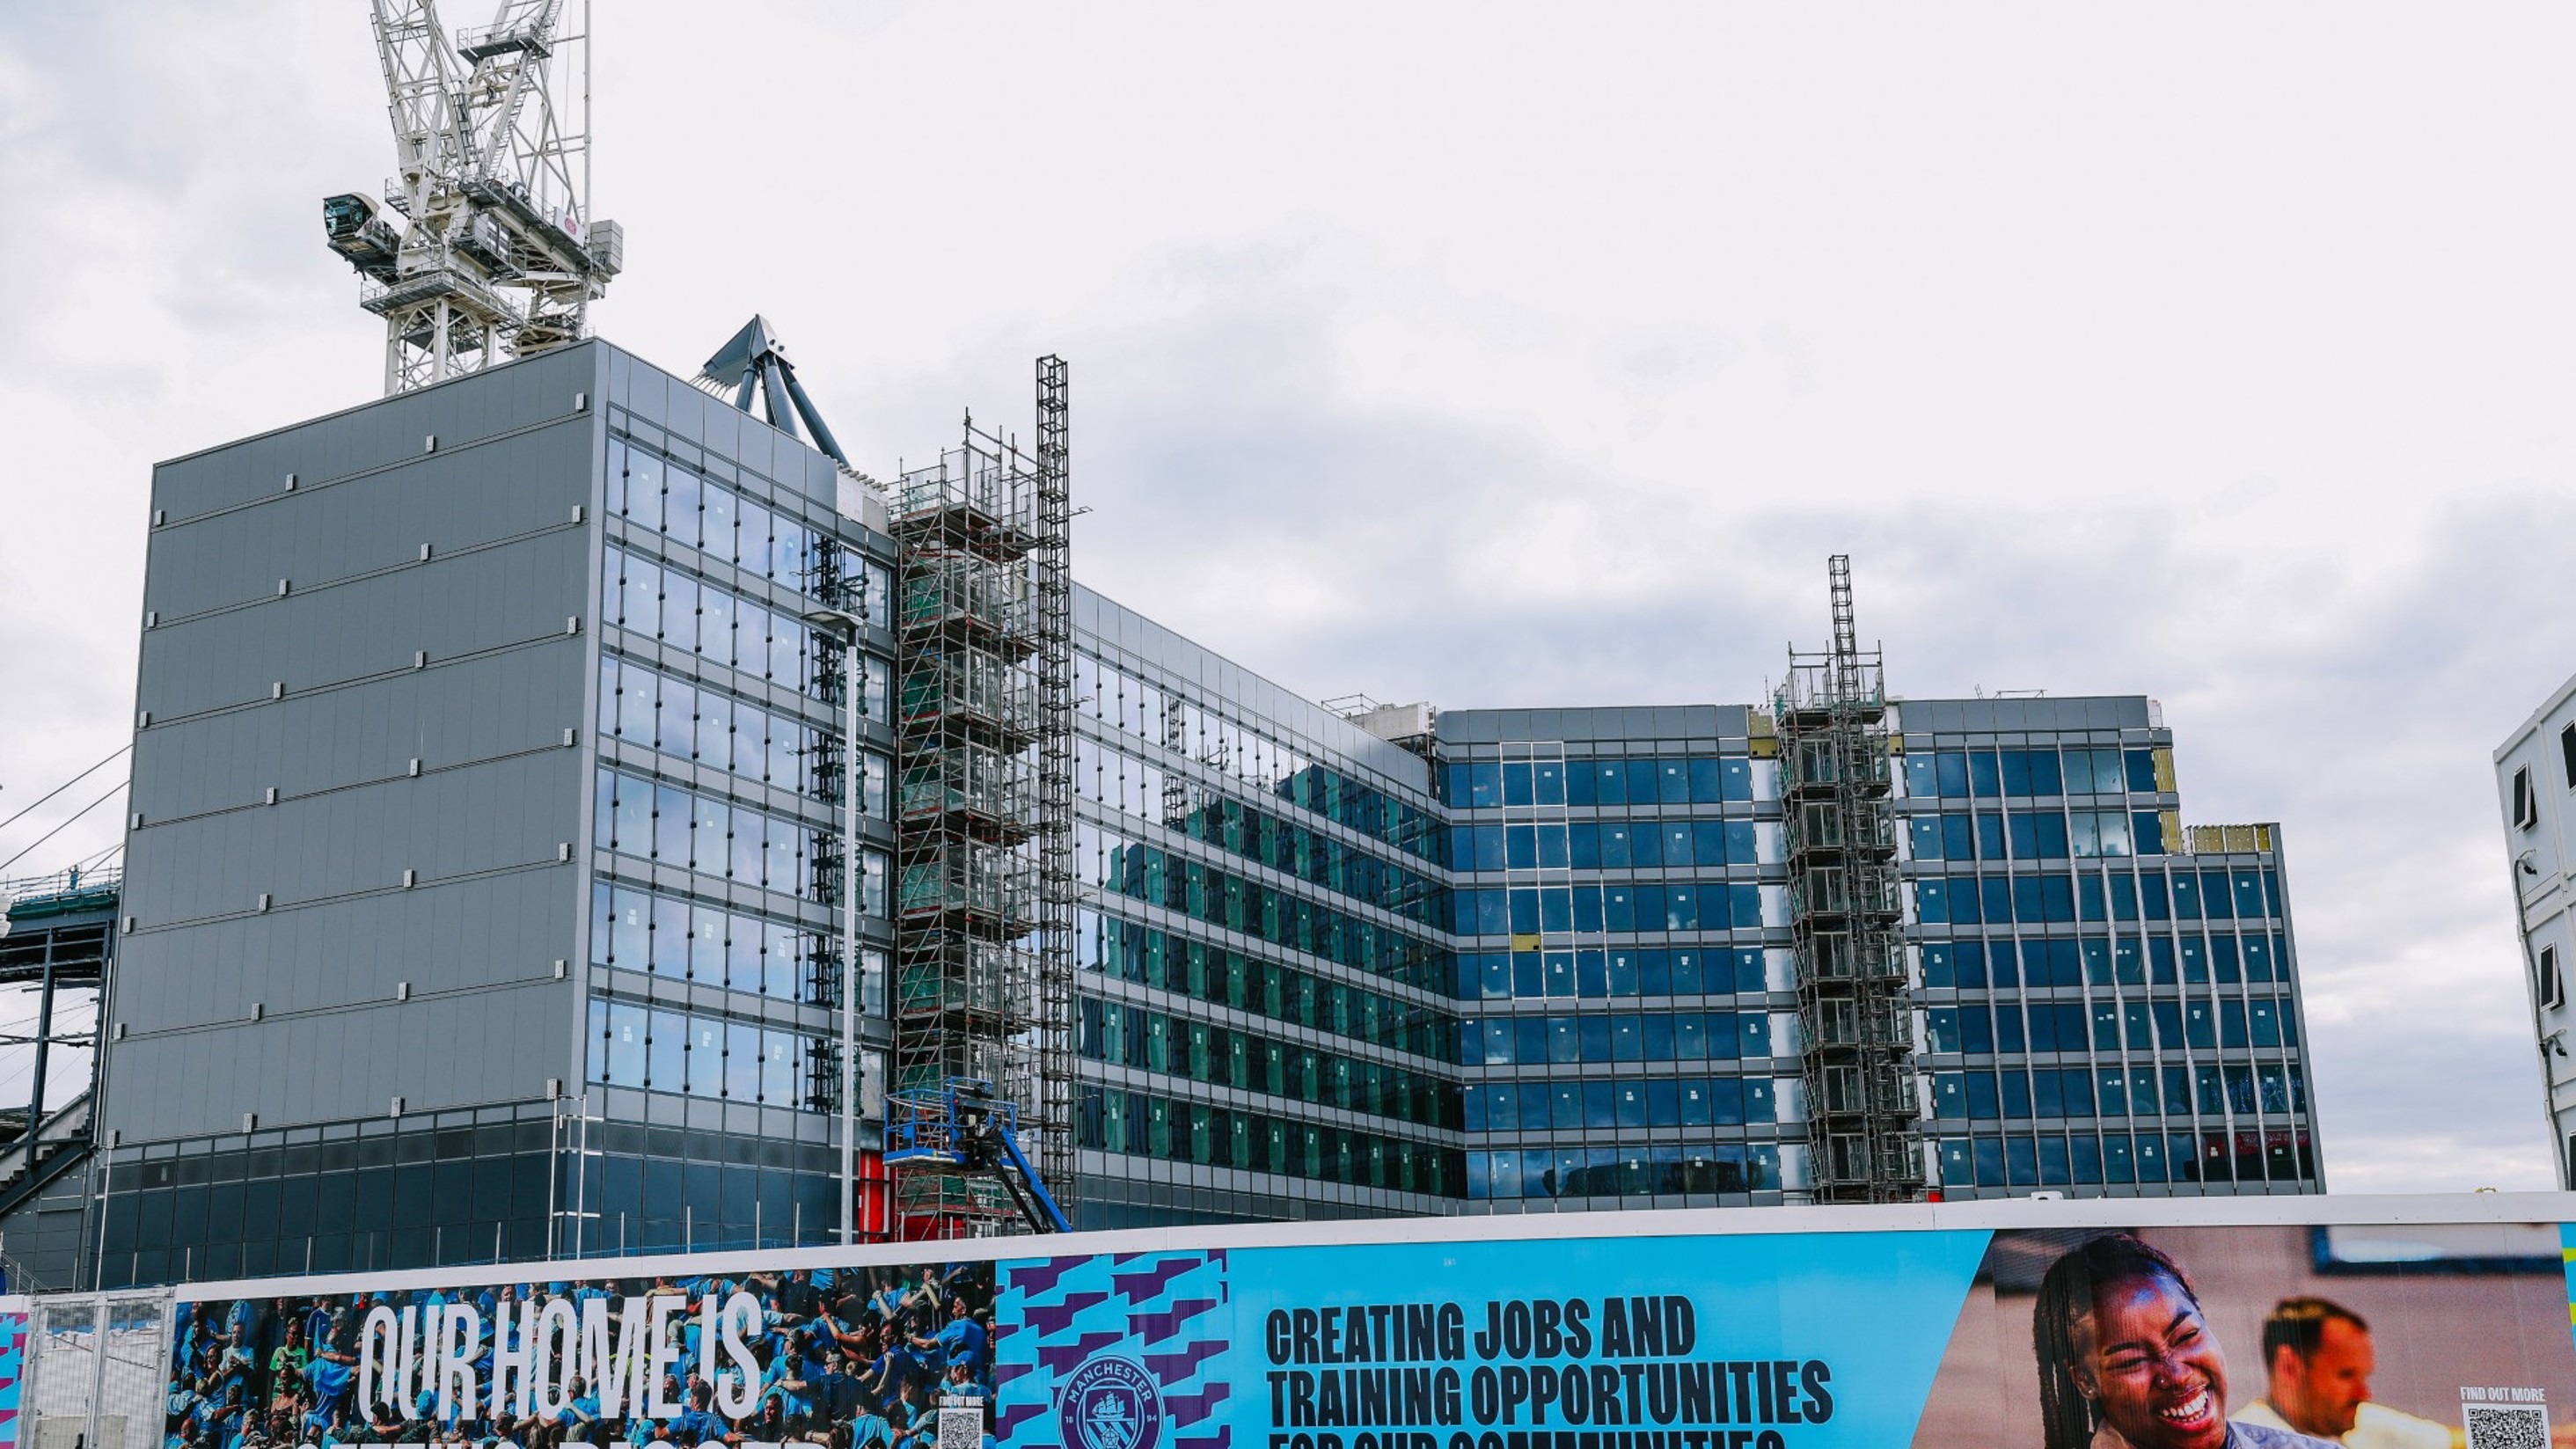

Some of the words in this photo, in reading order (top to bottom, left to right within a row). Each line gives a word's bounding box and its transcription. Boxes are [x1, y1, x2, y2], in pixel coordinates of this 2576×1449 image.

[358, 1303, 479, 1423] OUR
[491, 1294, 686, 1420] HOME
[700, 1292, 763, 1419] IS
[1266, 1302, 1466, 1365] CREATING
[1474, 1298, 1592, 1360] JOBS
[1601, 1295, 1696, 1358] AND
[1068, 1363, 1153, 1403] MANCHESTER
[1266, 1366, 1462, 1427] TRAINING
[1470, 1359, 1833, 1426] OPPORTUNITIES
[2460, 1387, 2486, 1401] FIND
[2487, 1387, 2509, 1401] OUT
[2511, 1387, 2546, 1401] MORE
